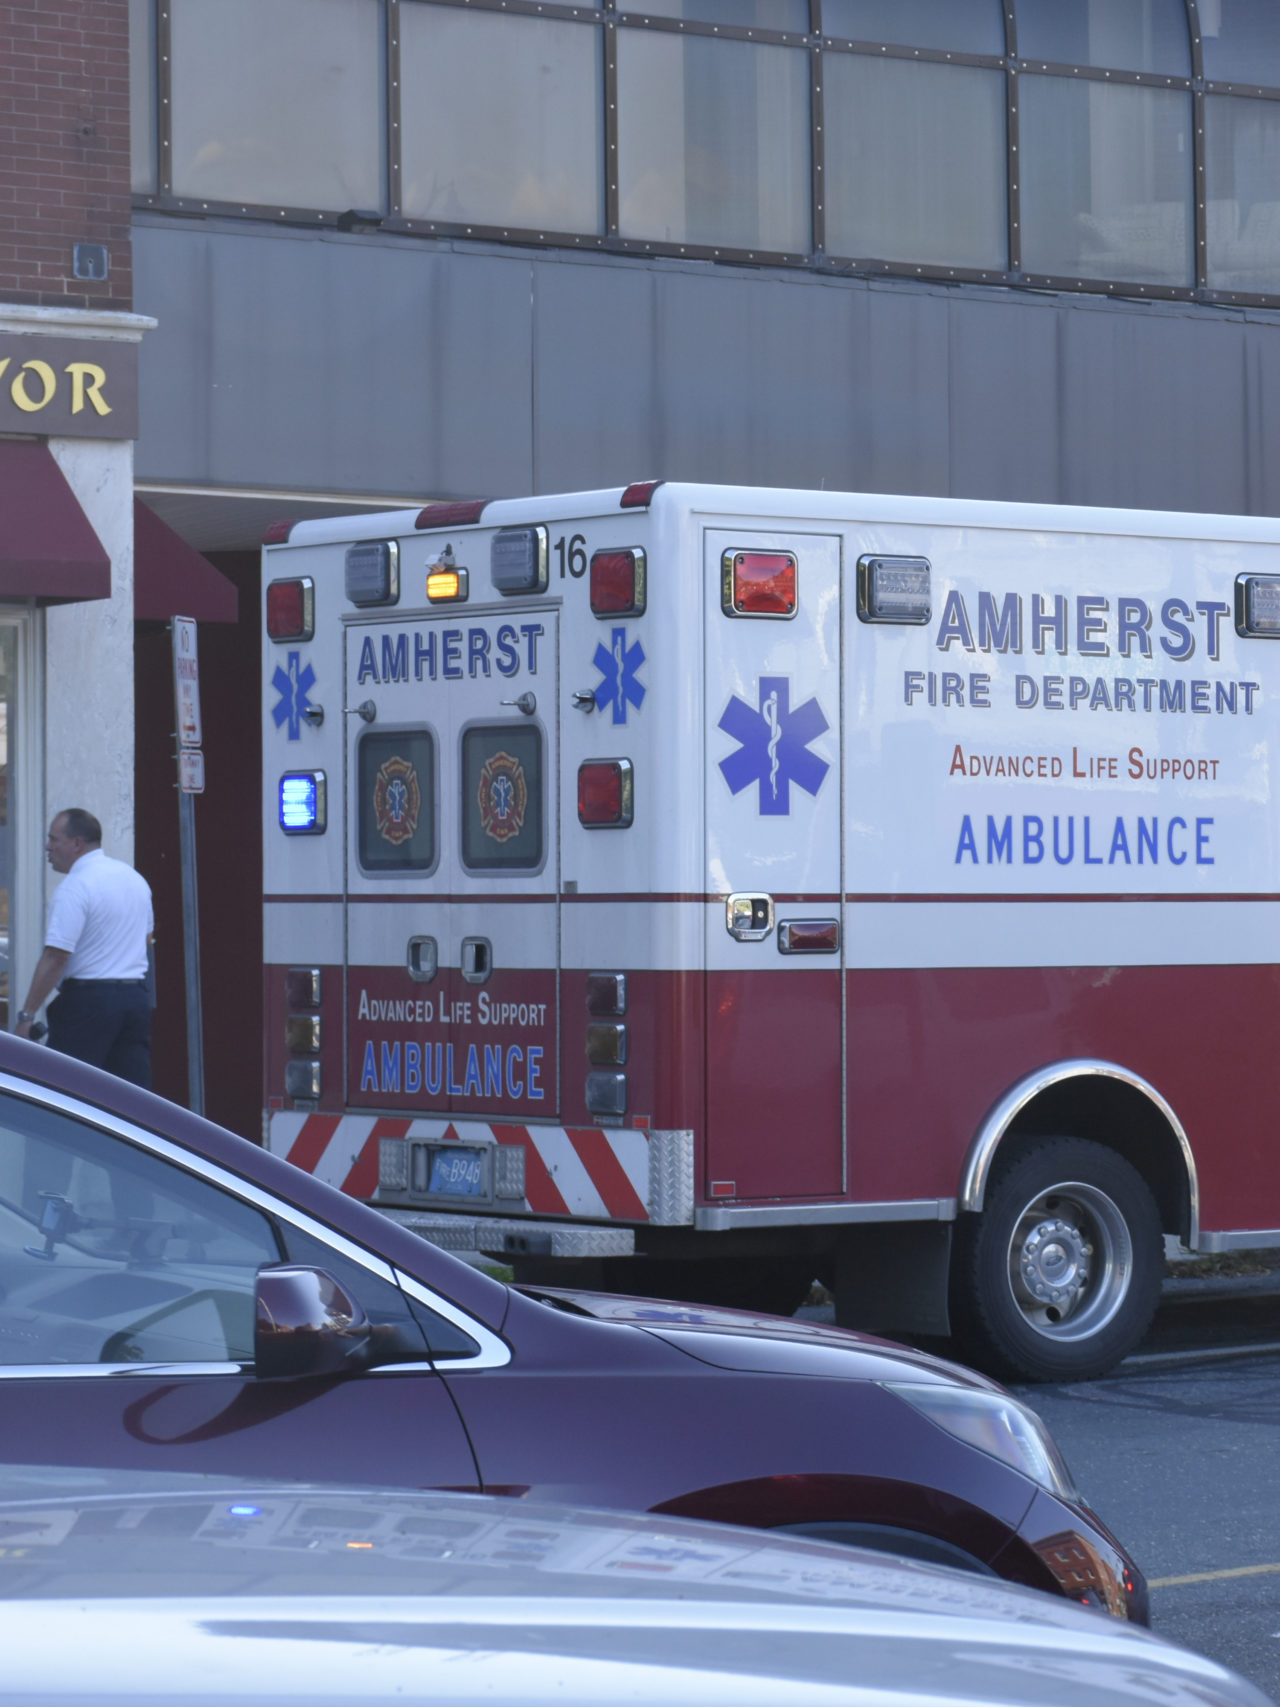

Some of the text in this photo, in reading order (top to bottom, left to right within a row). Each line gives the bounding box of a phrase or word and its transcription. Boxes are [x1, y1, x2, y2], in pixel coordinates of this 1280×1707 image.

[554, 533, 588, 579] 16
[936, 590, 1231, 662] AMHERST
[357, 623, 544, 684] AMHERST
[903, 671, 1260, 714] FIRE DEPARTMENT
[949, 744, 1220, 781] ADVANCED LIFE SUPPORT
[954, 814, 1215, 866] AMBULANCE
[358, 989, 547, 1026] ADVANCED LIFE SUPPORT
[361, 1040, 545, 1099] AMBULANCE
